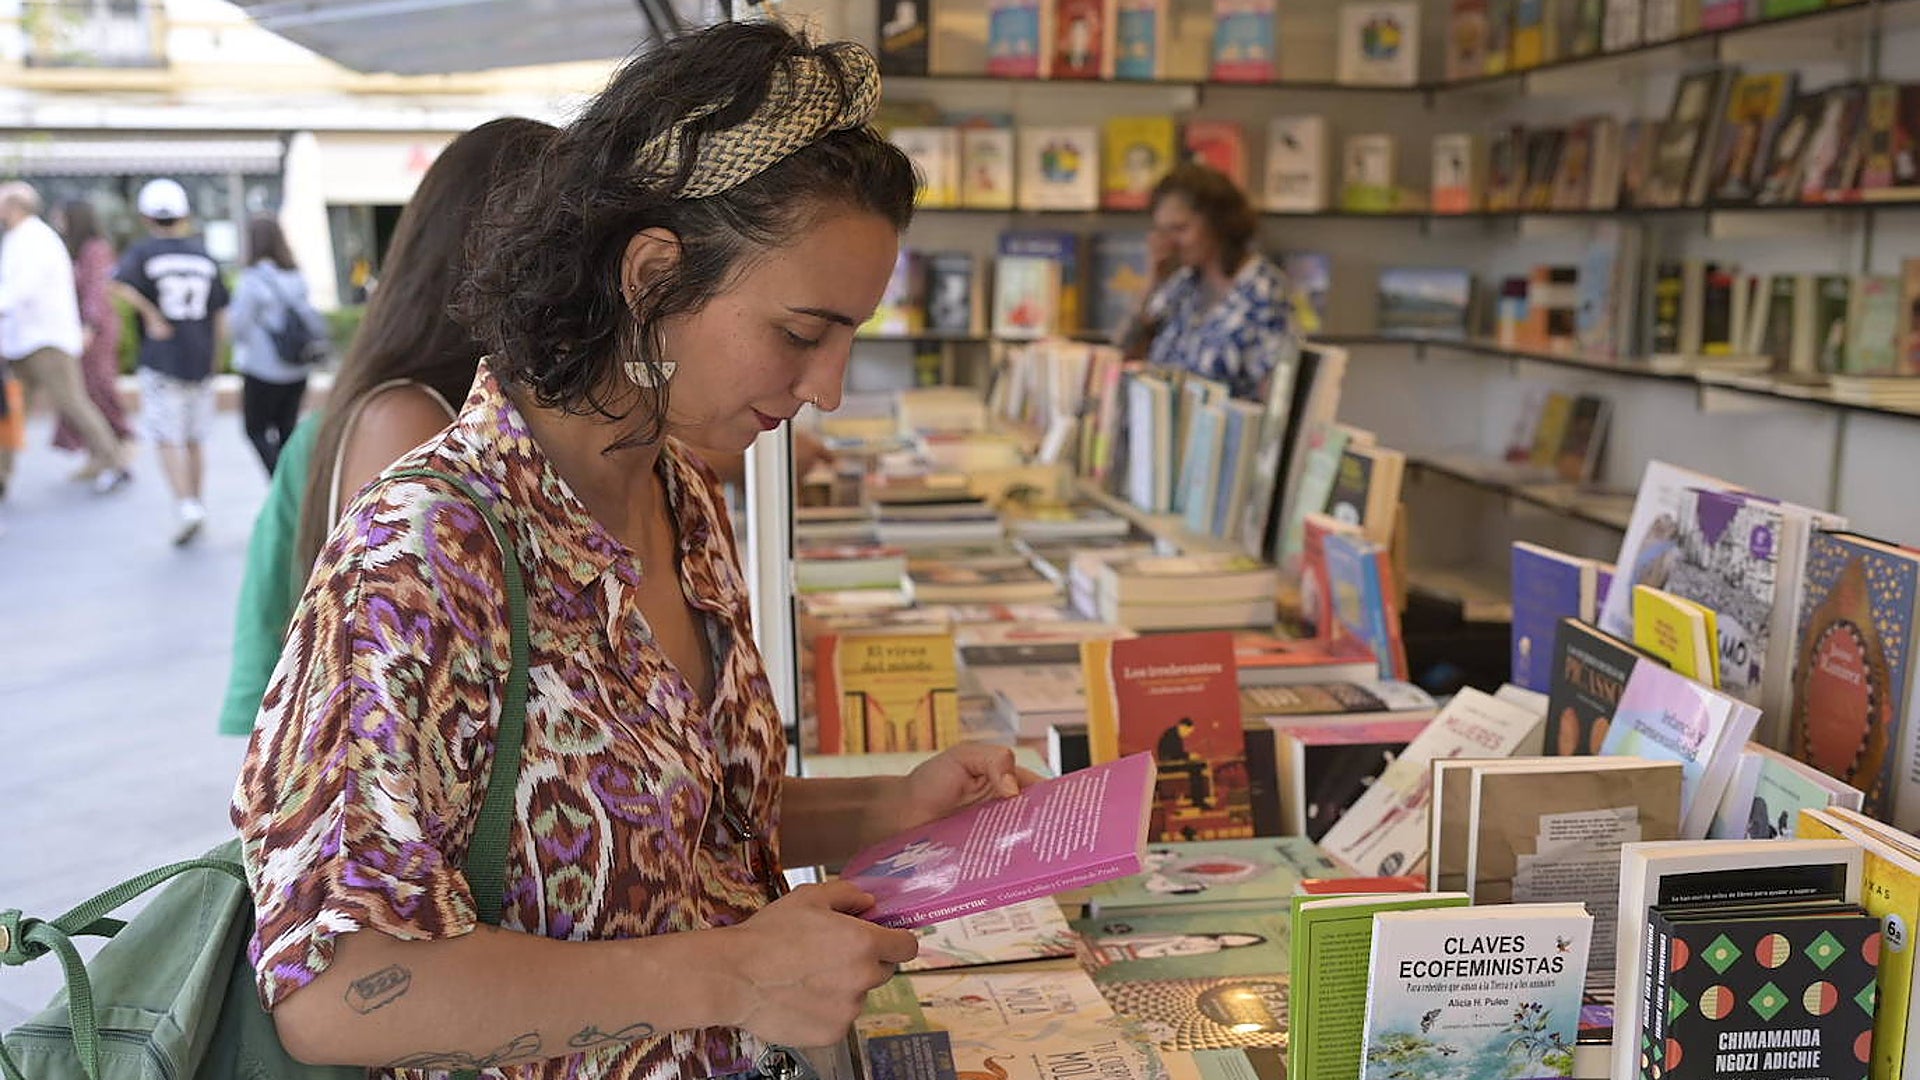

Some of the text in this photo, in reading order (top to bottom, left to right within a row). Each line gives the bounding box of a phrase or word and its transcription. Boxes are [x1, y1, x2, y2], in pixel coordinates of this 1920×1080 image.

[927, 898, 989, 919] conocerme
[1444, 935, 1526, 955] CLAVES
[1399, 956, 1565, 979] ECOFEMINISTAS
[1490, 980, 1508, 990] Tierra
[1448, 998, 1509, 1008] Alicia H. Puleo
[1718, 1029, 1821, 1051] CHIMAMANDA
[1715, 1050, 1821, 1074] NGOZI ADICHIE
